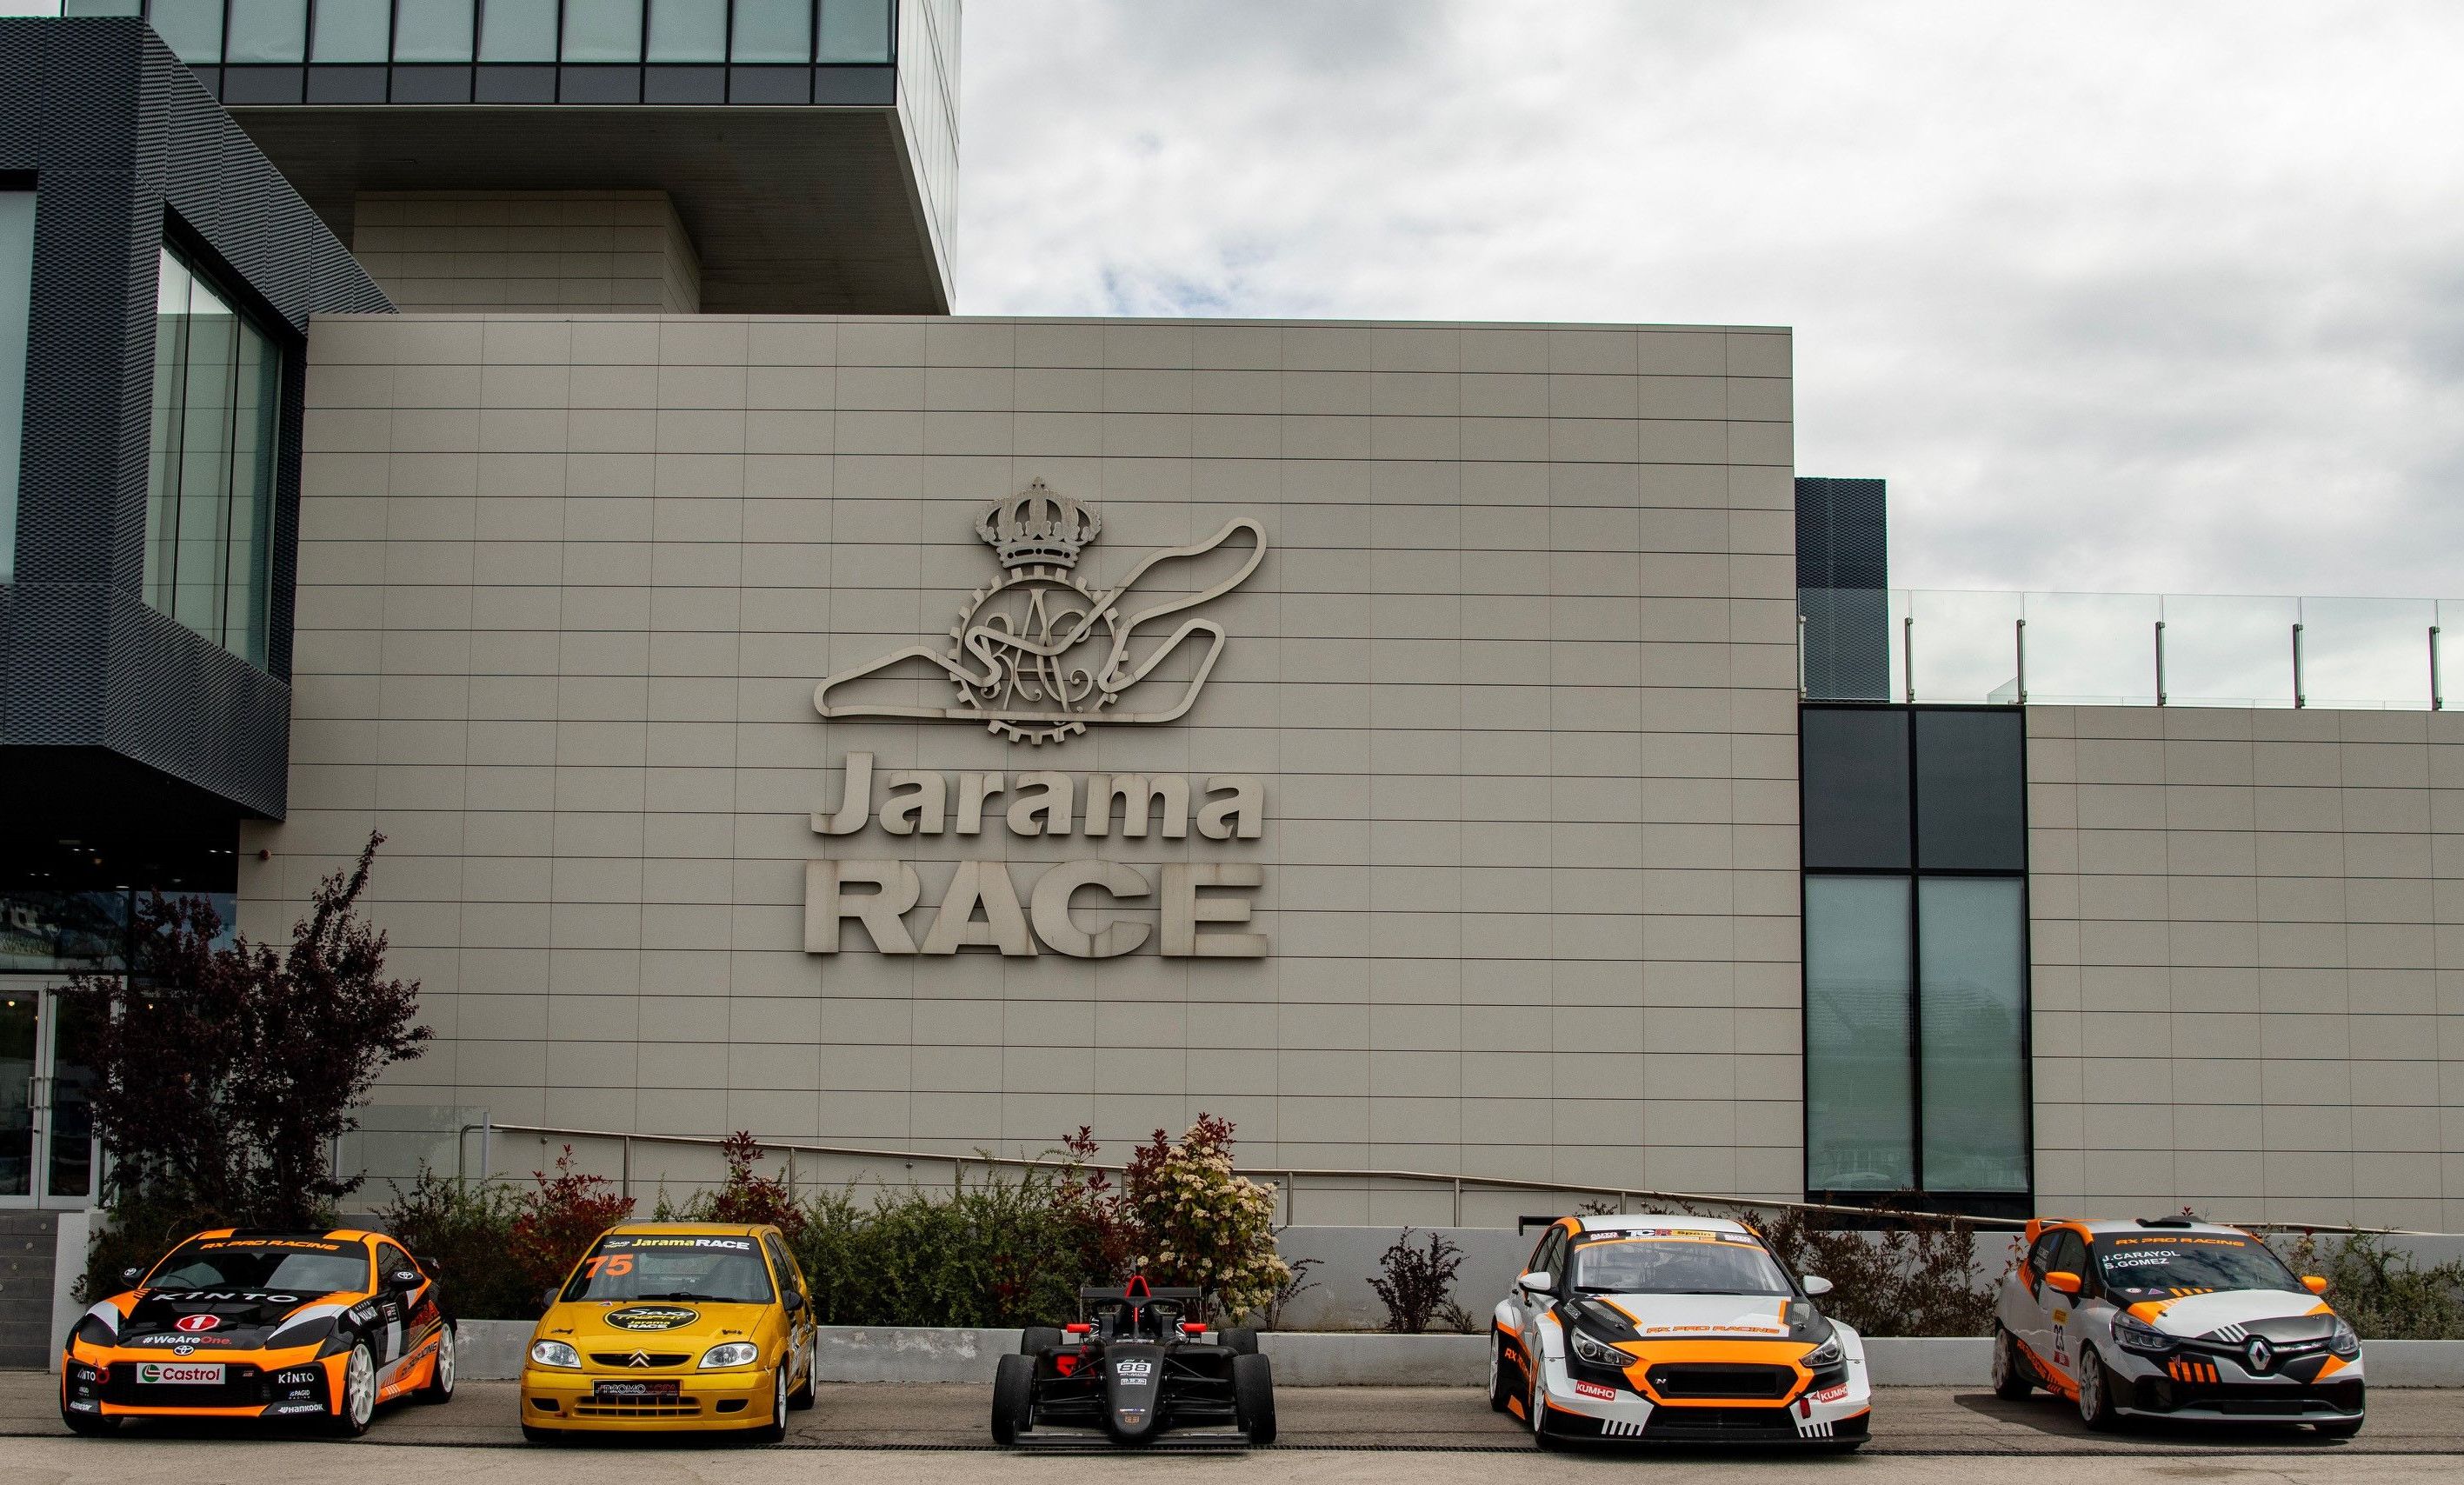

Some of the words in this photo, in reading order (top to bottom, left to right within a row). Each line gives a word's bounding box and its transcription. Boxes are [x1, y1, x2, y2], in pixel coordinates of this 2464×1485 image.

[811, 751, 1264, 840] Jarama
[804, 859, 1269, 957] RACE
[267, 1241, 340, 1250] RACING
[2181, 1238, 2246, 1247] RACING
[2102, 1250, 2181, 1262] J.CARAYOL
[585, 1254, 634, 1279] 75
[2105, 1257, 2169, 1269] S.GOMEZ
[190, 1316, 205, 1329] 1
[163, 1368, 220, 1381] Castrol
[1576, 1382, 1615, 1399] KUMHO
[1821, 1387, 1848, 1401] KUMHO
